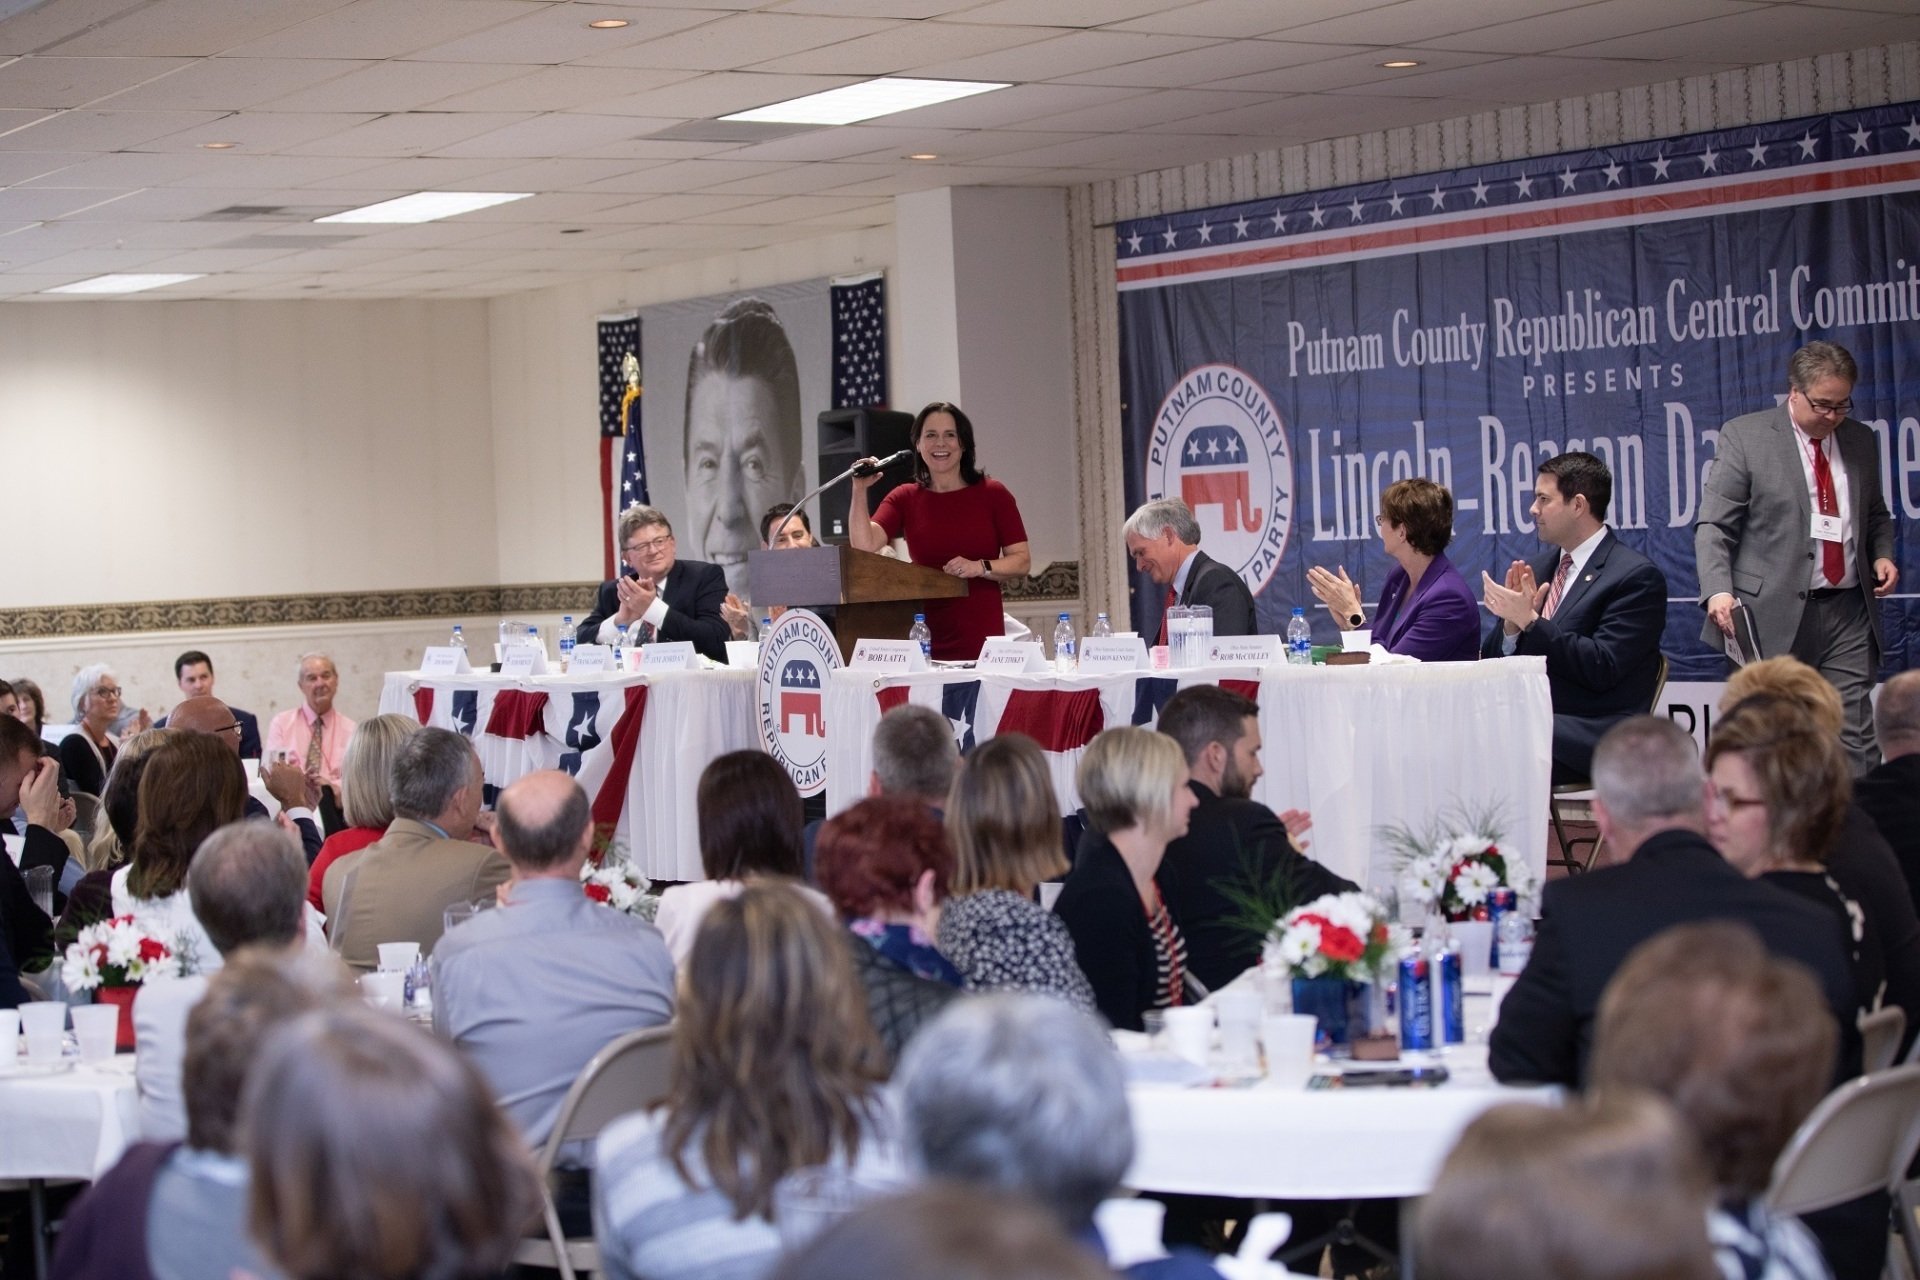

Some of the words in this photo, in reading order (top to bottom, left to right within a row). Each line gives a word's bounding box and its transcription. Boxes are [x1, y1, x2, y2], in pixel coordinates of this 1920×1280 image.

[1287, 321, 1384, 377] Putnam
[1392, 308, 1486, 371] County
[1494, 288, 1657, 367] Republican
[1666, 268, 1780, 342] Central
[1523, 363, 1683, 398] PRESENTS
[1151, 371, 1213, 467] PUTNAM
[1217, 371, 1286, 459] COUNTY
[1251, 487, 1289, 583] PARTY
[763, 622, 801, 684] PUTNAM
[867, 654, 883, 662] BOB
[883, 654, 906, 663] LATTA
[1220, 652, 1234, 660] ROB
